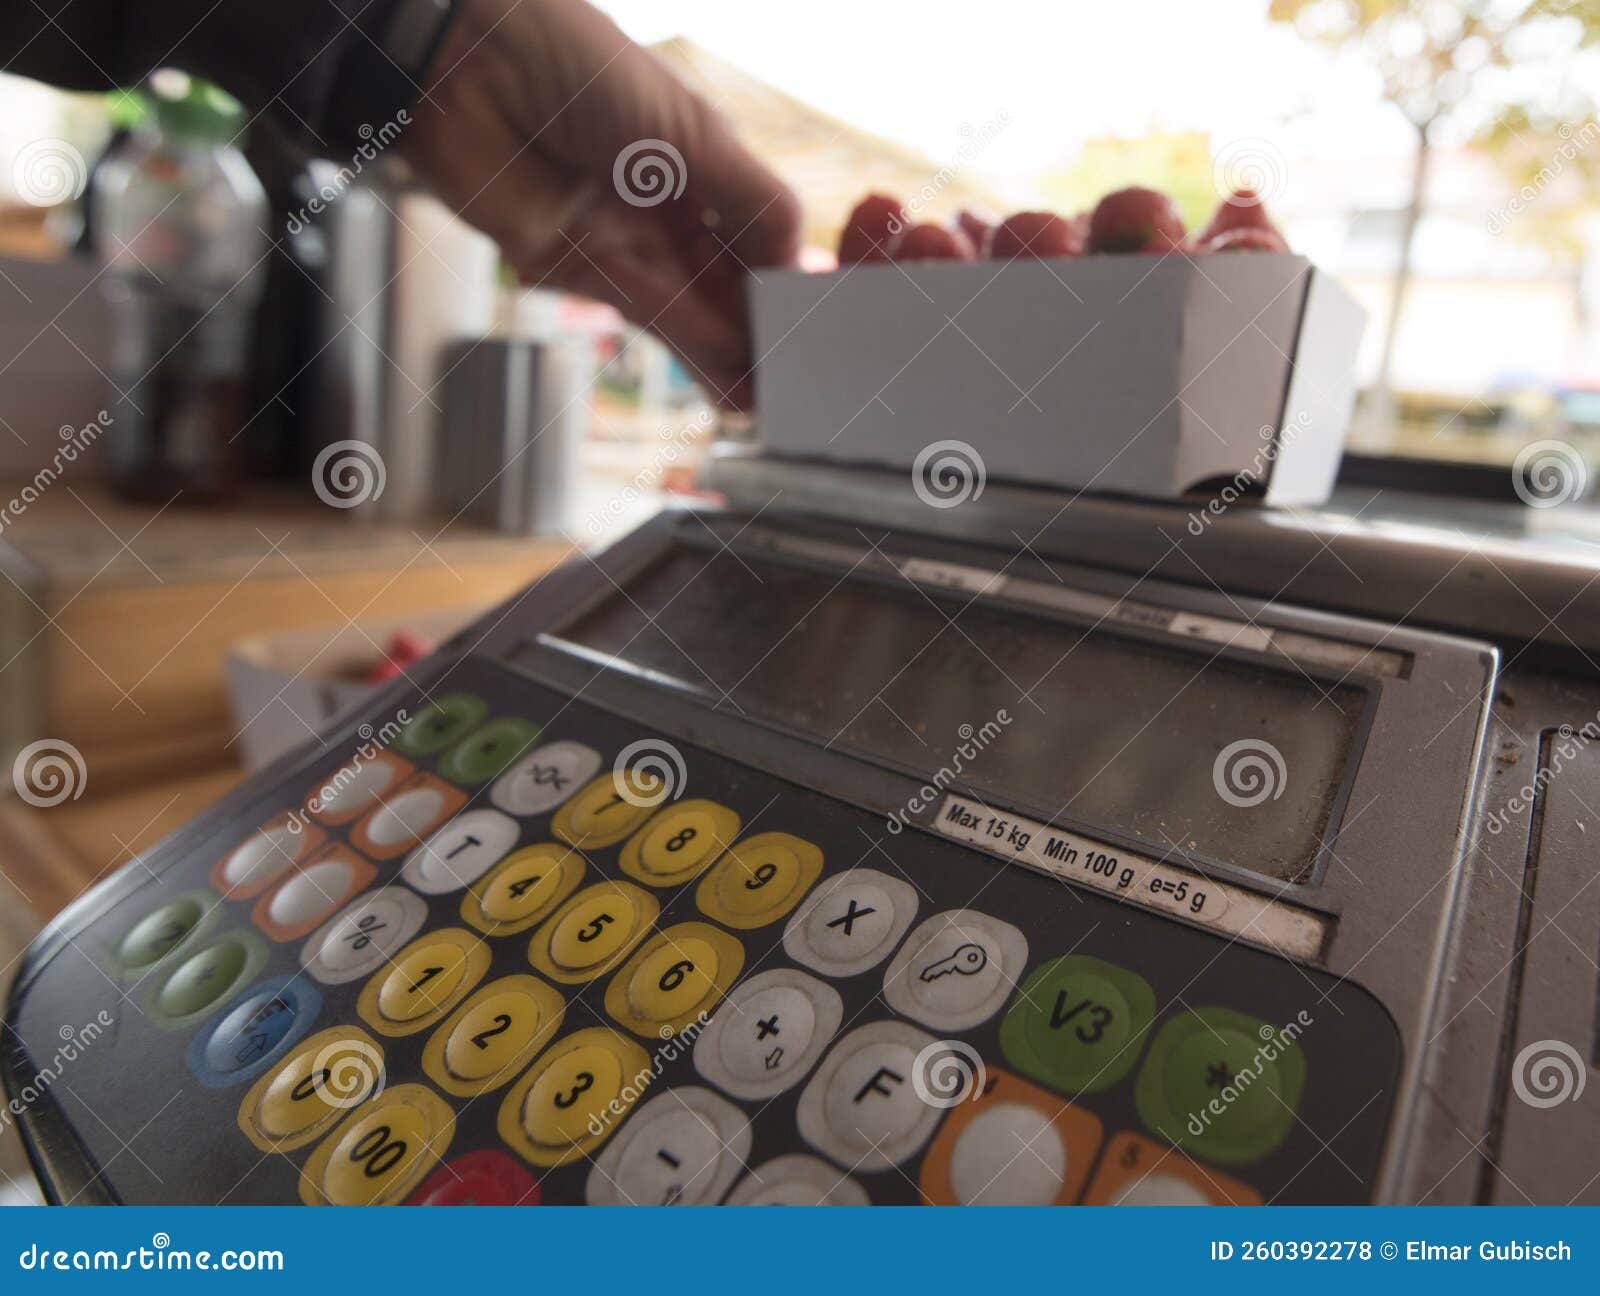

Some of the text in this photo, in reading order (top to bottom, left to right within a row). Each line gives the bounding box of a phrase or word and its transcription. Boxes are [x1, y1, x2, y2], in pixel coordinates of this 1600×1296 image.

[446, 834, 481, 860] T
[666, 827, 697, 852] 8
[946, 803, 1208, 913] Max 15 kg Min 100 g e=5 g
[508, 875, 542, 899] 4
[744, 863, 777, 890] 9
[343, 914, 388, 951] %
[577, 913, 615, 943] 5
[407, 966, 445, 994] 1
[659, 960, 695, 991] 6
[470, 1014, 513, 1050] 2
[1049, 989, 1114, 1044] V3
[554, 1071, 594, 1109] 3
[852, 1065, 905, 1104] F
[350, 1125, 408, 1178] 00
